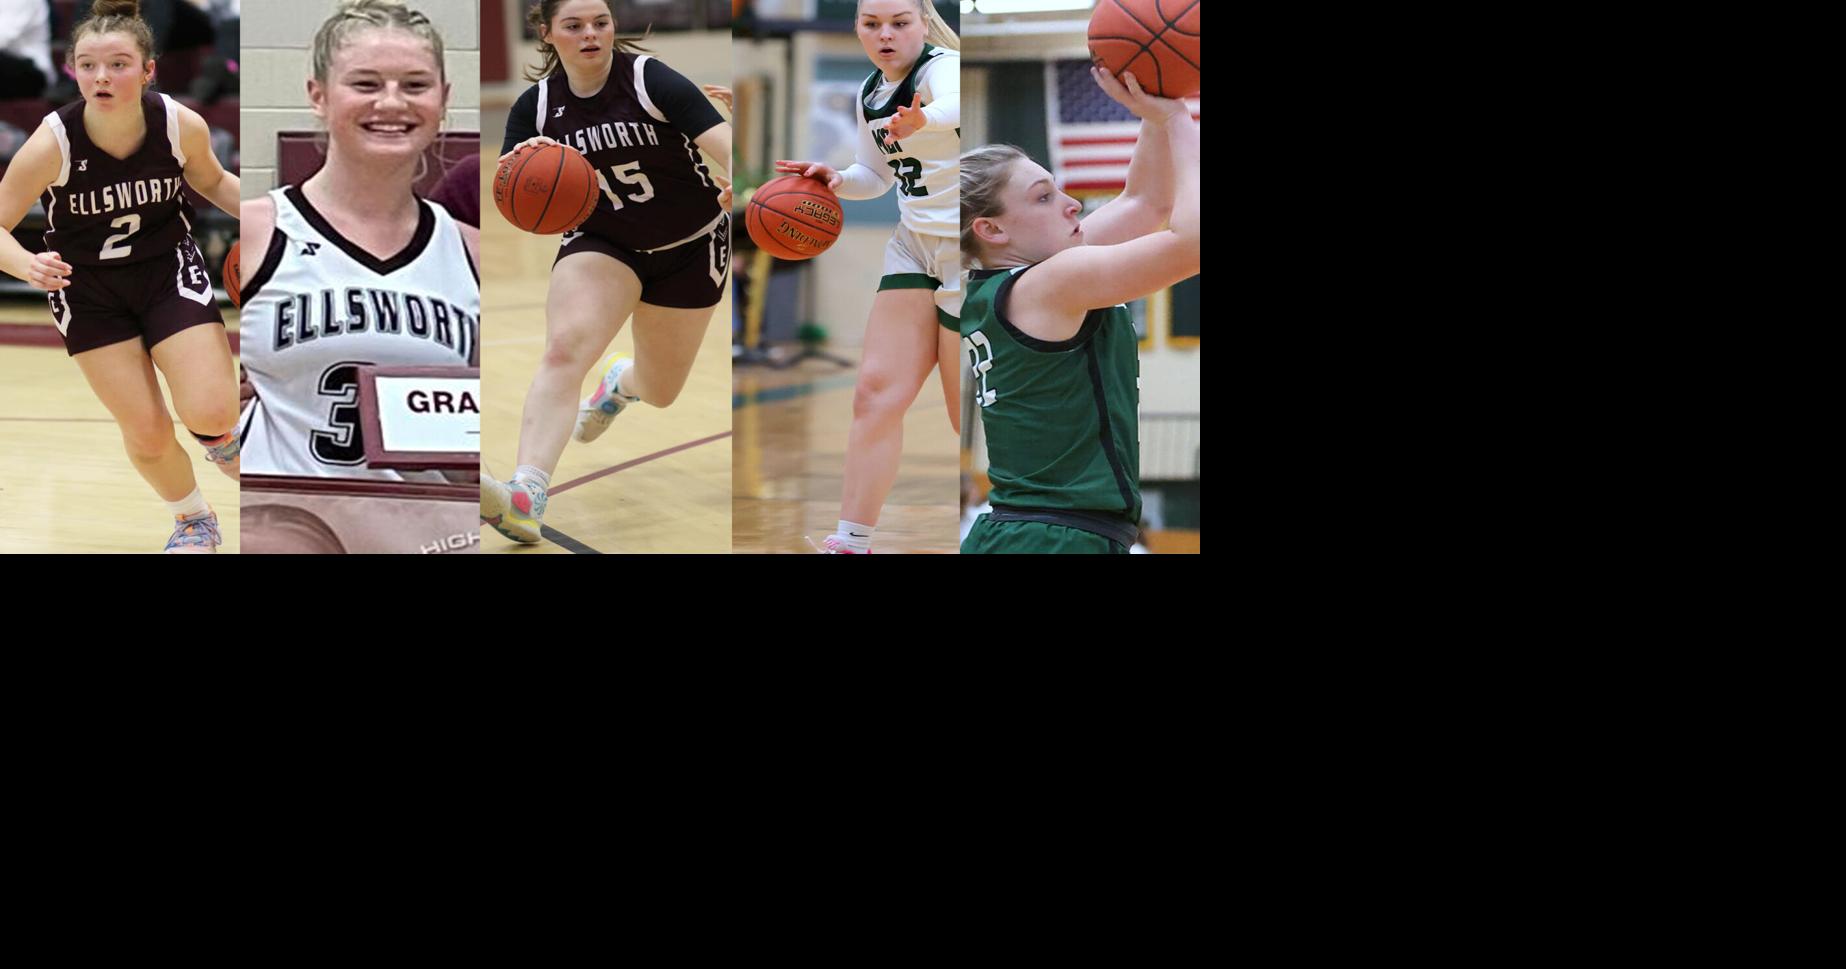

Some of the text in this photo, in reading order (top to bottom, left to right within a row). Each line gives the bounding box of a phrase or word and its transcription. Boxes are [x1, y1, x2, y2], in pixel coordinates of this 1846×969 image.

[556, 122, 659, 155] SWORTH
[70, 176, 181, 215] ELLSWORTH
[595, 160, 654, 211] 15
[794, 206, 837, 226] EGACY
[99, 213, 141, 261] 2
[406, 391, 480, 414] GRA
